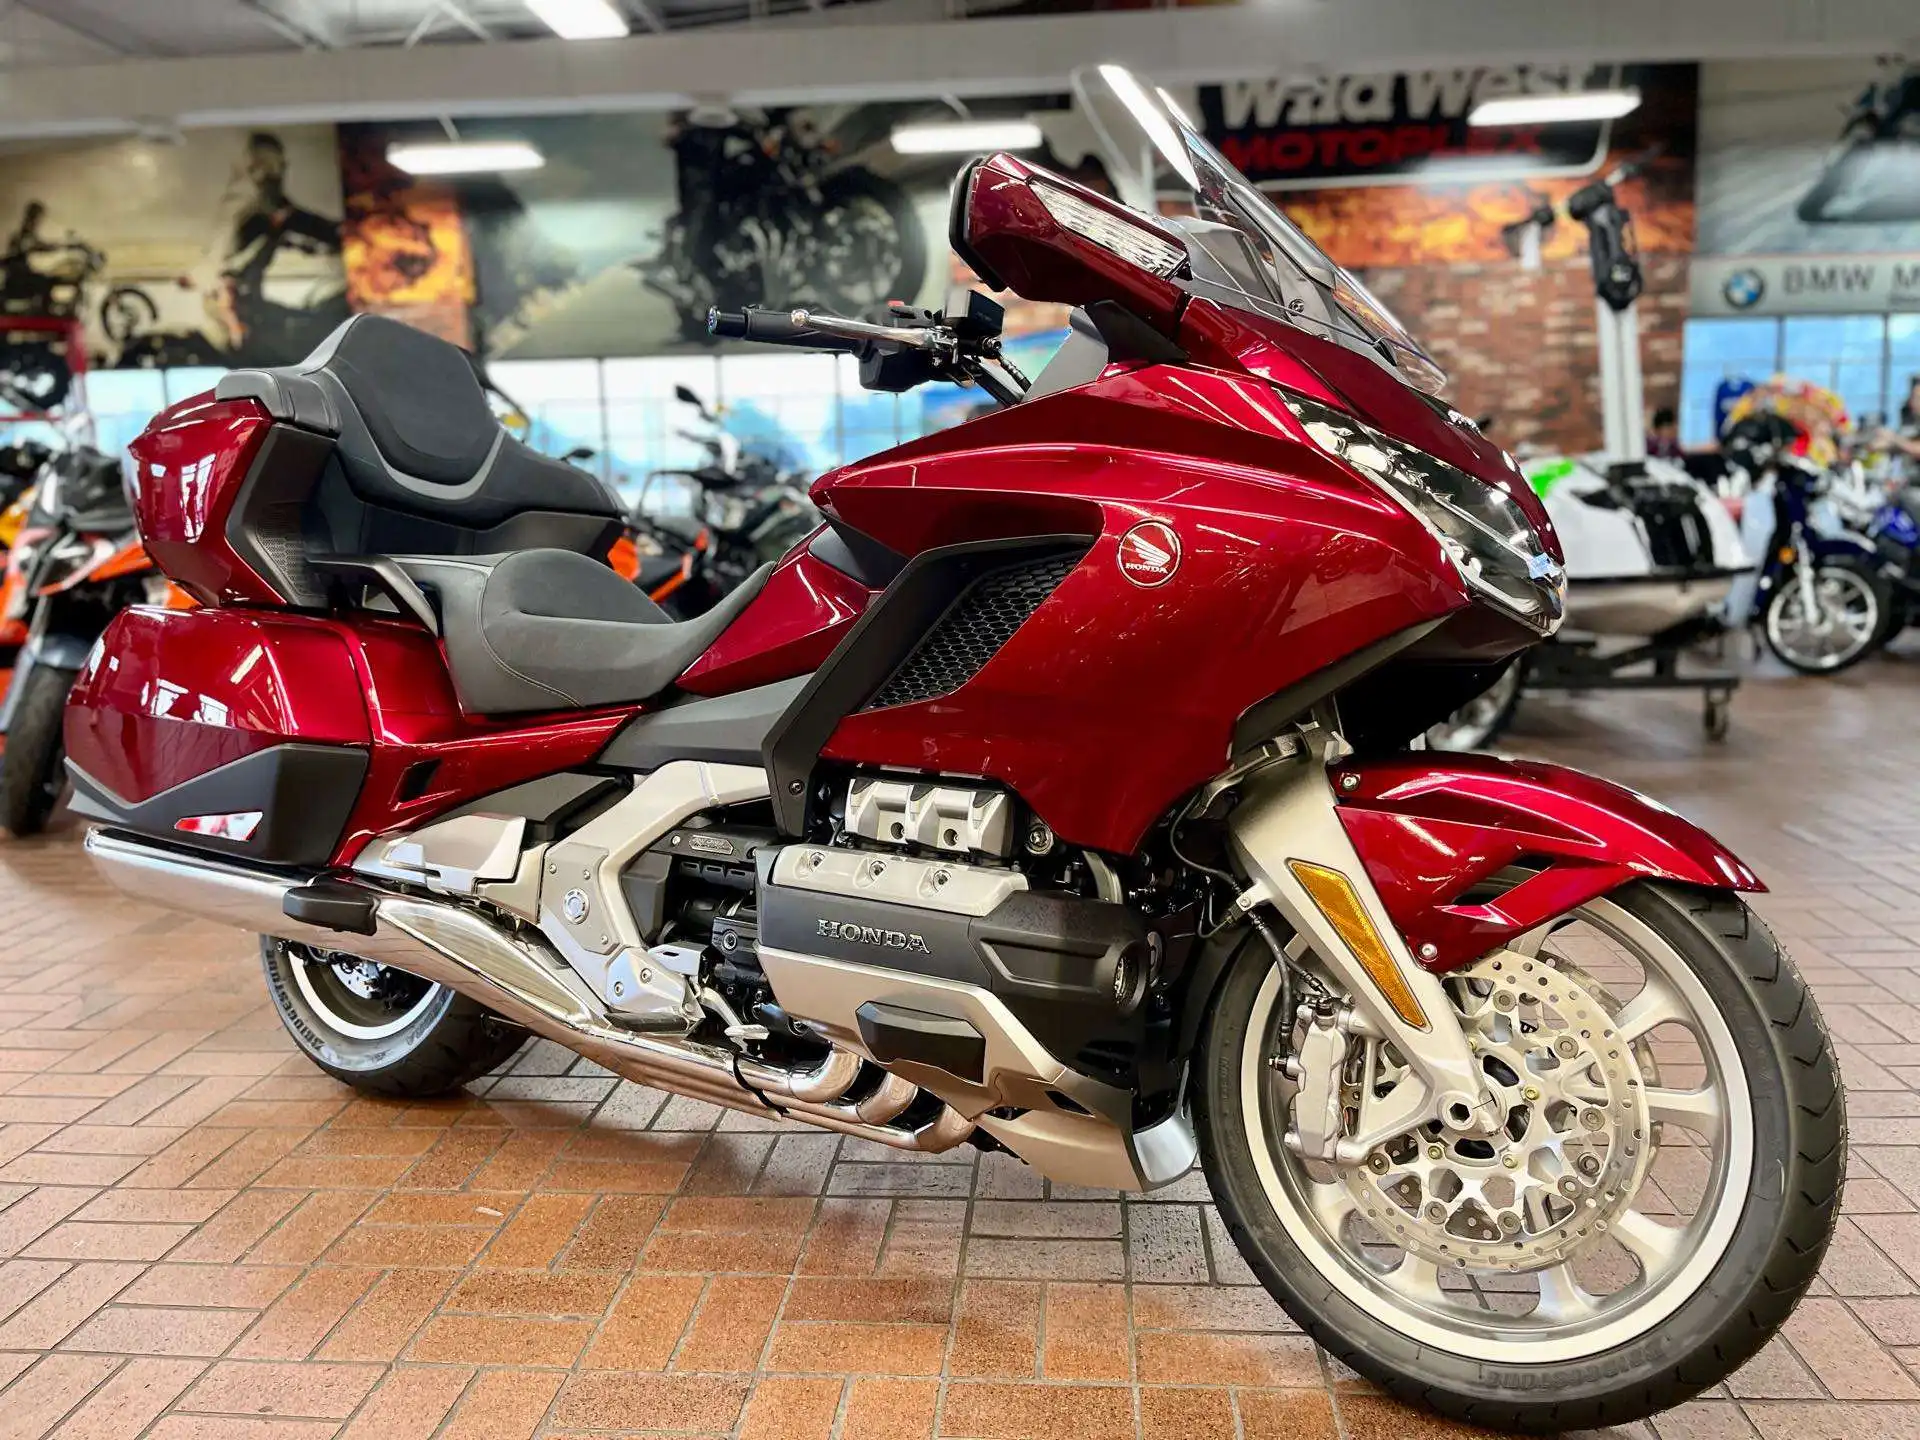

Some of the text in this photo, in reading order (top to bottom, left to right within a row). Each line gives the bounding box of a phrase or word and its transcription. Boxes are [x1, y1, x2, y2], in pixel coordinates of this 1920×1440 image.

[1221, 74, 1397, 129] Wild
[1221, 124, 1547, 172] MOTOPLEX
[1784, 265, 1876, 293] BMW
[1125, 562, 1169, 574] HONDA
[816, 918, 932, 954] HONDA
